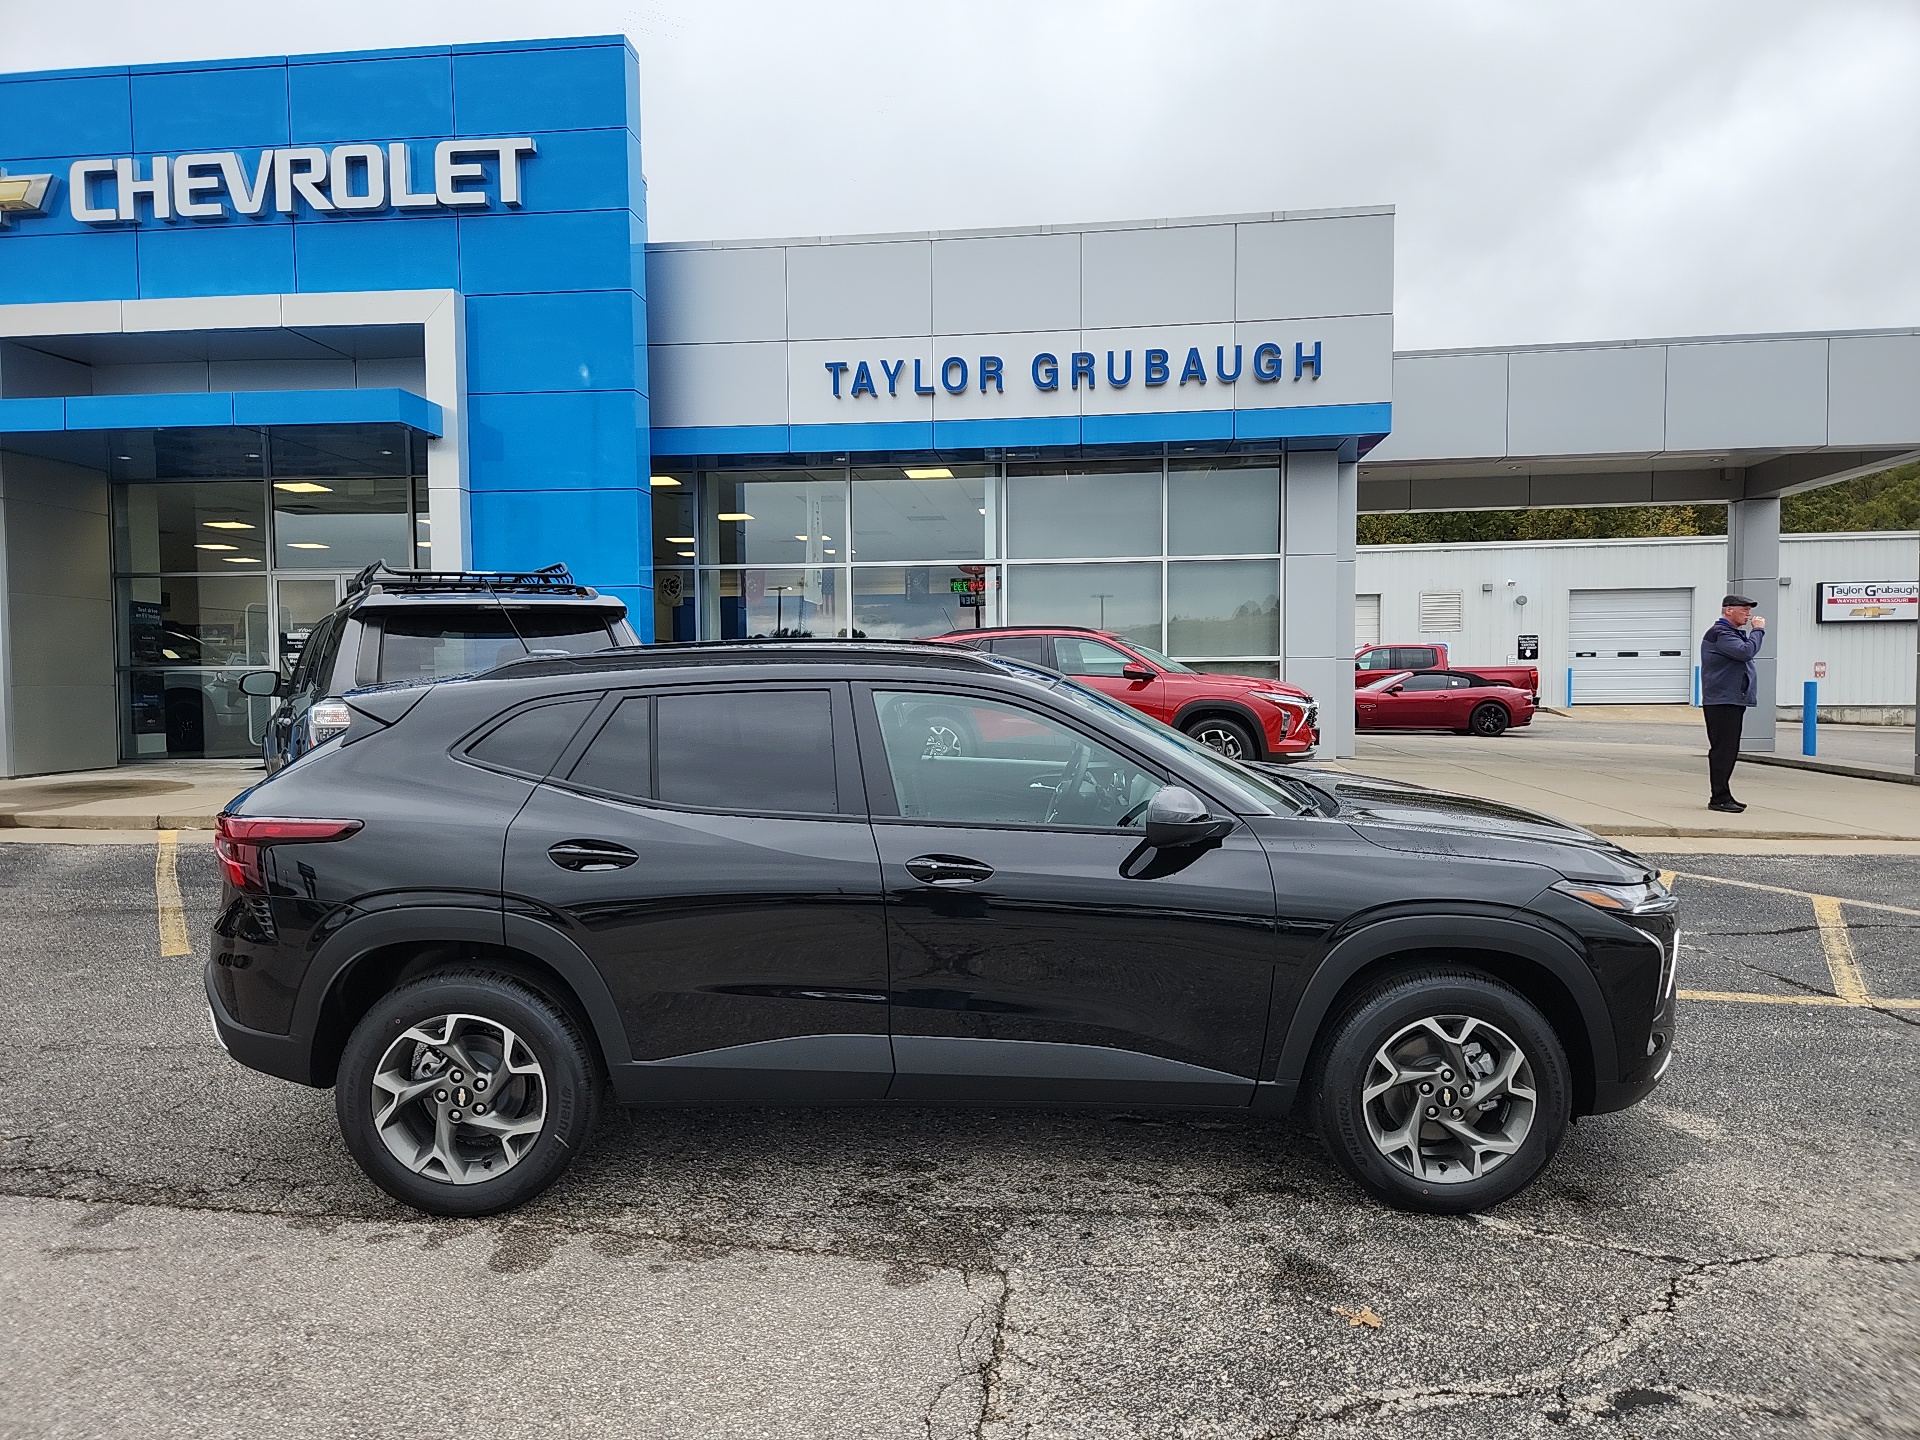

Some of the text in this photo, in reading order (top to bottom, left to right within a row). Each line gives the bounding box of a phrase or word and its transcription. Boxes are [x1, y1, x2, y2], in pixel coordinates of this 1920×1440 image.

[69, 137, 537, 225] CHEVROLET
[825, 340, 1324, 399] TAYLOR GRUBAUGH
[1828, 584, 1918, 597] Taylor Grubaugh
